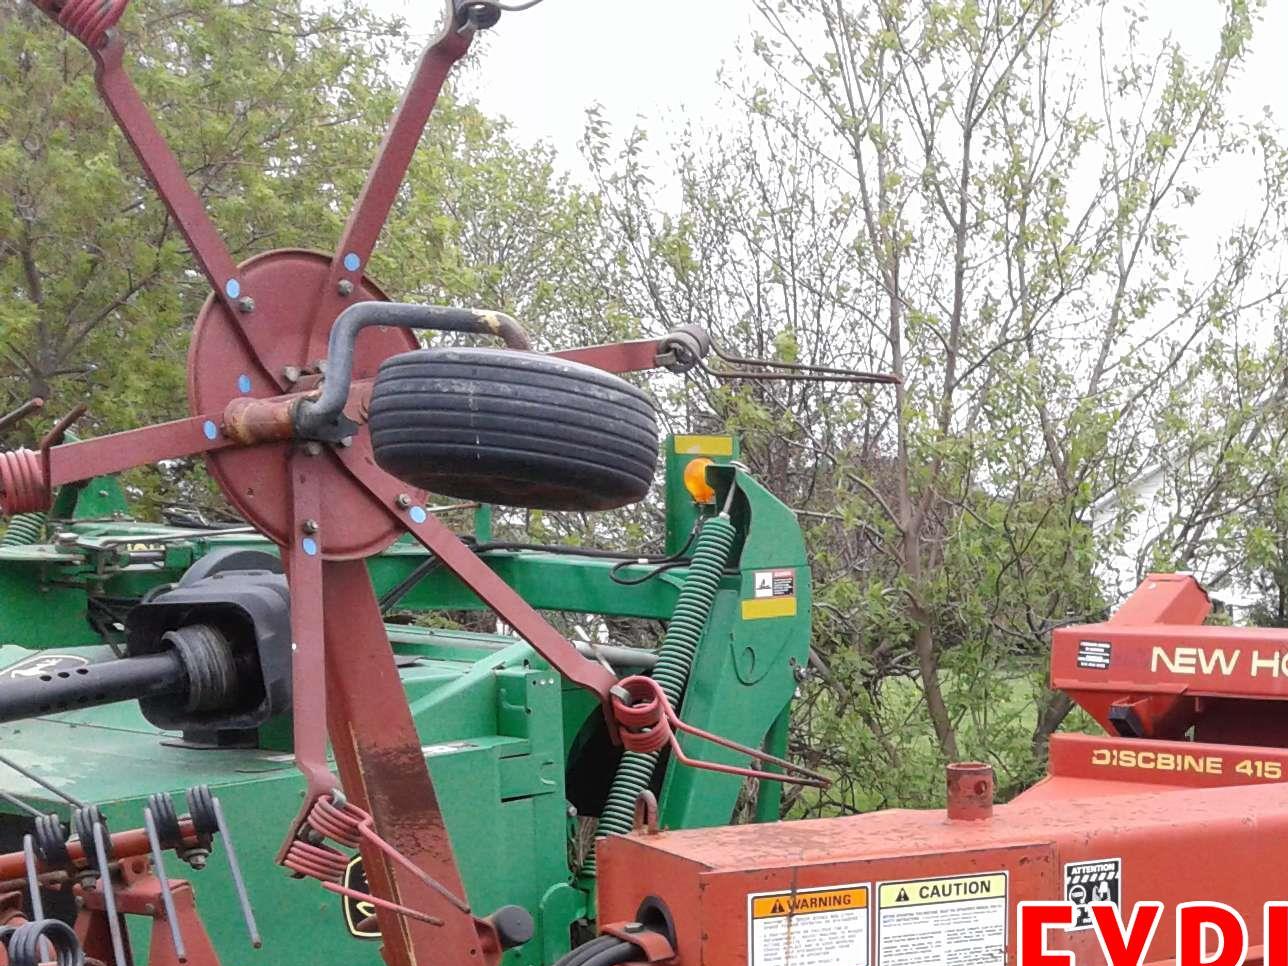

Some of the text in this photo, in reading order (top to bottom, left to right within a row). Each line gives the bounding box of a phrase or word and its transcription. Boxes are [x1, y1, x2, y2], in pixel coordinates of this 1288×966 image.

[1151, 647, 1240, 675] NEW
[1092, 749, 1282, 779] DISCBINE 415
[1071, 863, 1115, 875] ATTENTION
[918, 880, 991, 899] CAUTION
[787, 894, 852, 911] WARNING
